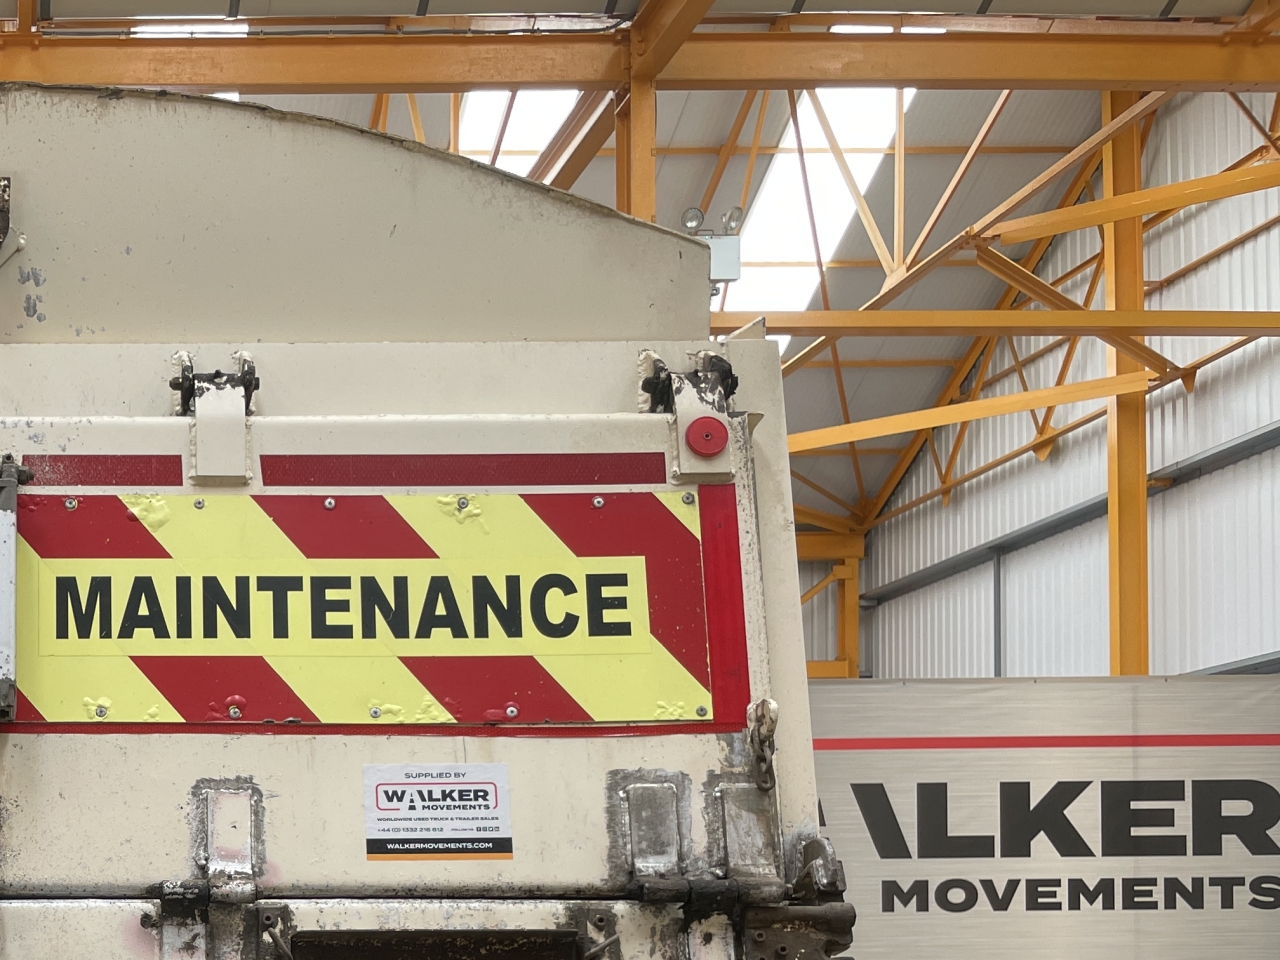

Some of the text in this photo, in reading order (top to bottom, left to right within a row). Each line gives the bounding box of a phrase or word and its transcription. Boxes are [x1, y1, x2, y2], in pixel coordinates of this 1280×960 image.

[53, 572, 633, 641] MAINTENANCE
[383, 789, 490, 811] WALKER
[881, 875, 1280, 913] MOVEMENTS
